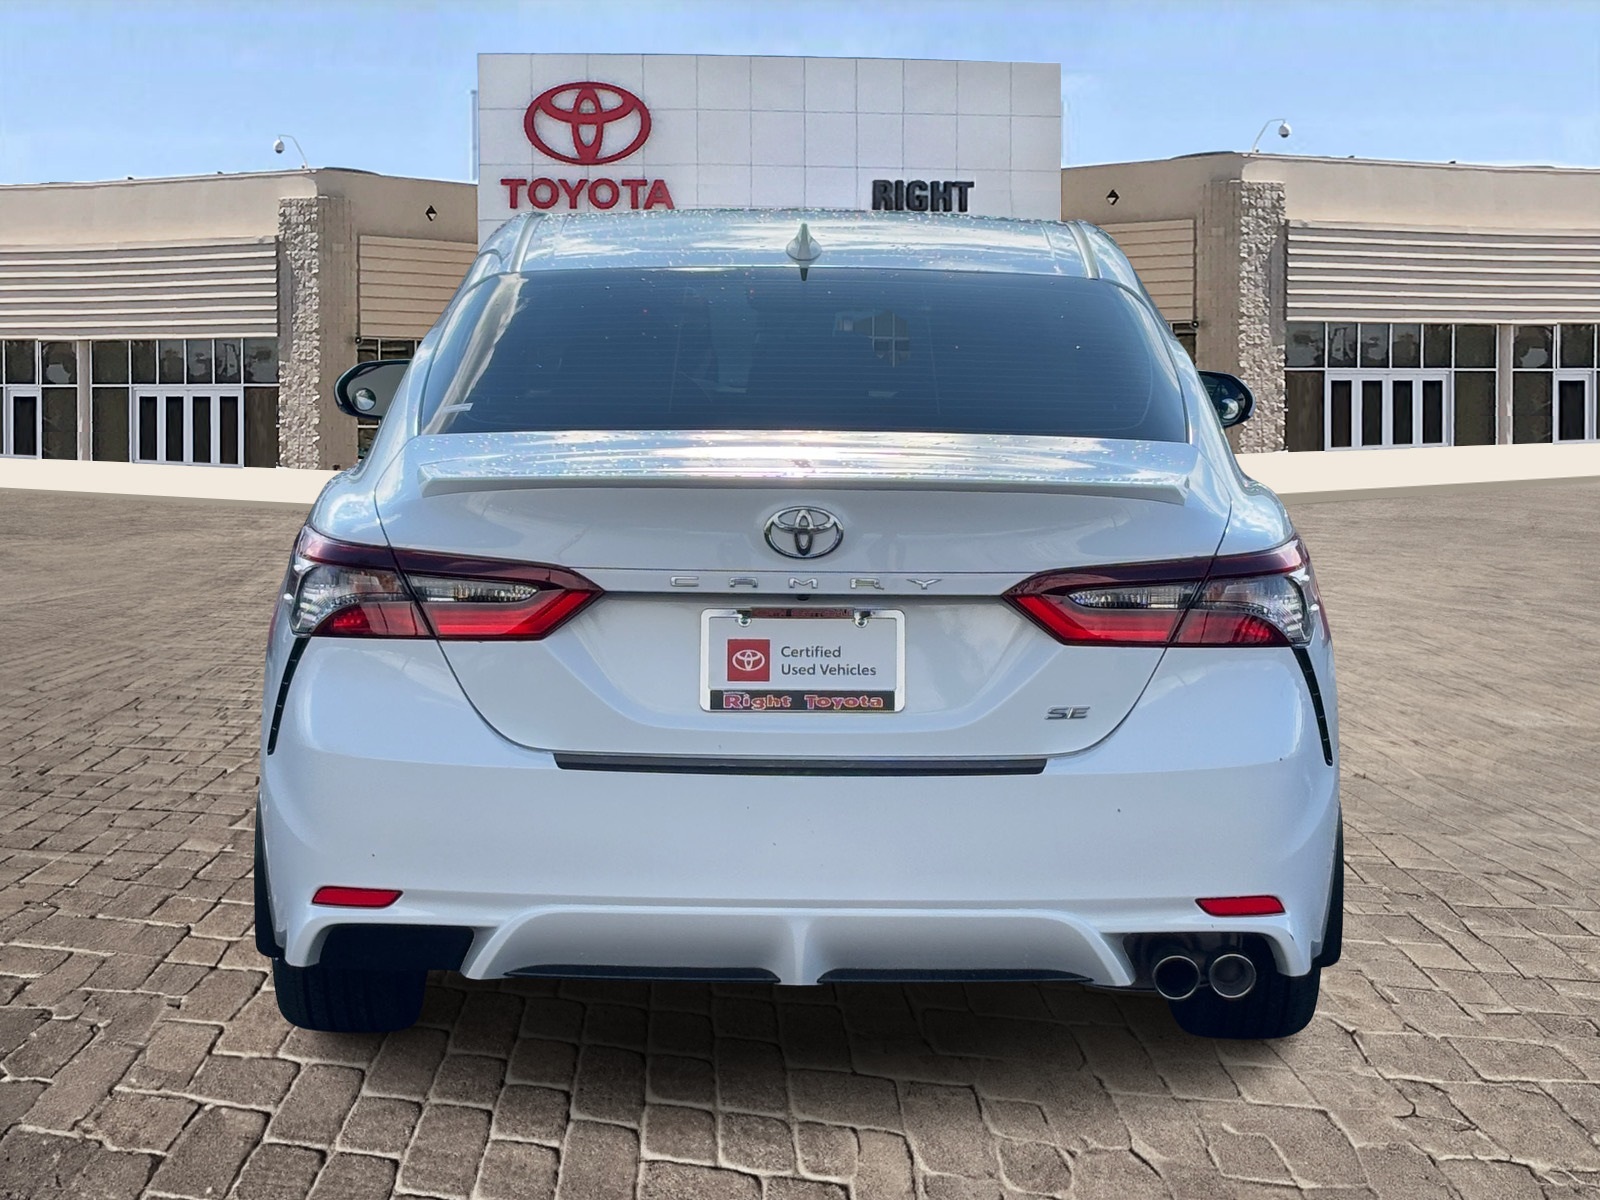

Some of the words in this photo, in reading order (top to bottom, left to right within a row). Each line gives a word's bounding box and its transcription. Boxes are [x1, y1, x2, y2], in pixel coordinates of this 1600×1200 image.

[501, 178, 674, 209] TOYOTA
[872, 179, 974, 212] RIGHT
[670, 576, 942, 590] CAMRY
[781, 645, 842, 659] Certified
[781, 664, 816, 676] Used
[820, 664, 877, 676] Vehicles
[722, 693, 792, 710] Right
[804, 694, 884, 710] Toyota
[1045, 705, 1090, 720] SE
